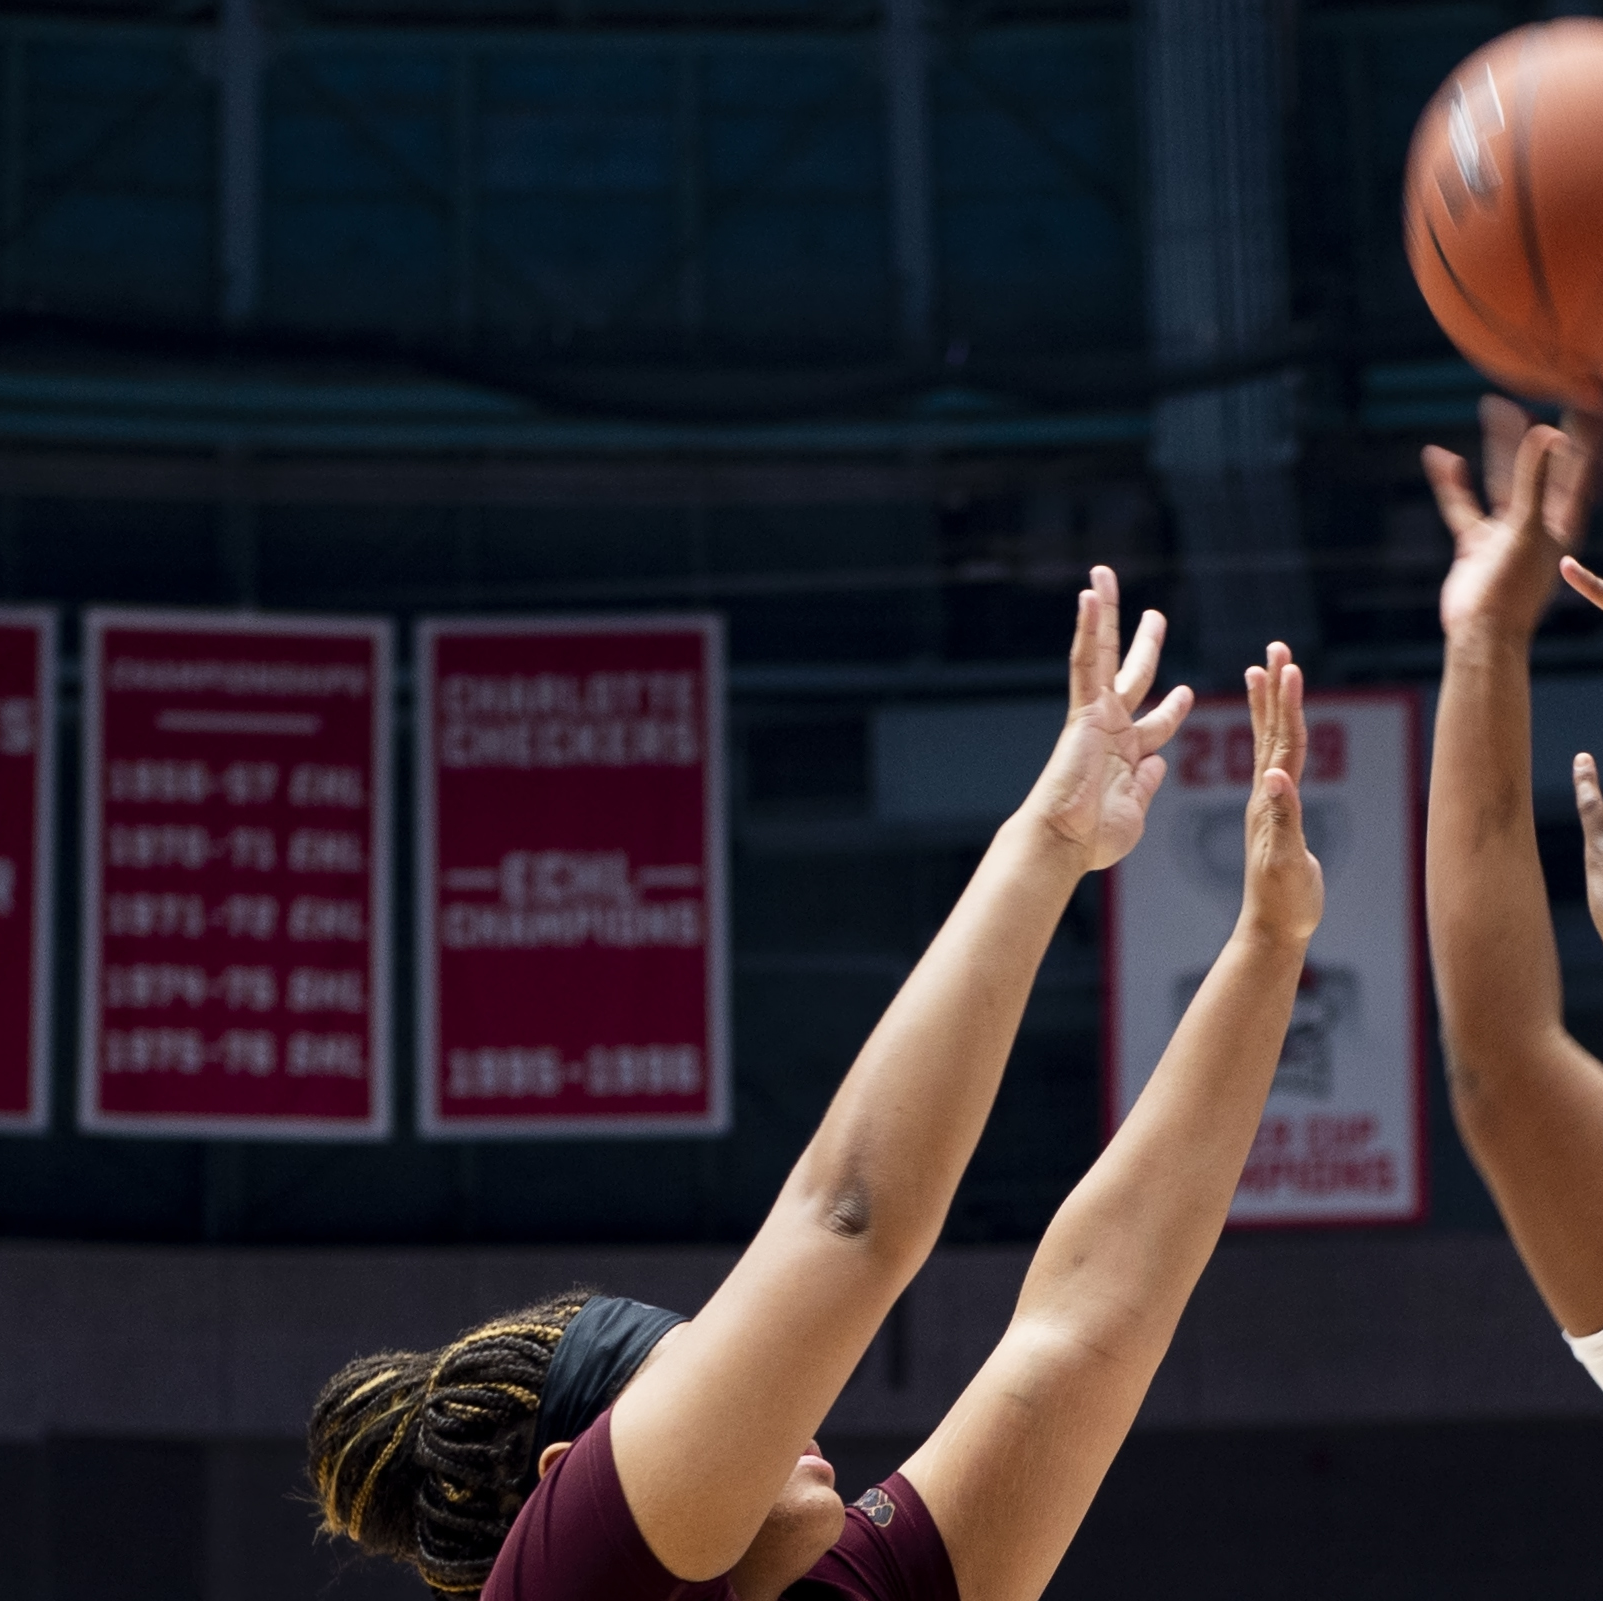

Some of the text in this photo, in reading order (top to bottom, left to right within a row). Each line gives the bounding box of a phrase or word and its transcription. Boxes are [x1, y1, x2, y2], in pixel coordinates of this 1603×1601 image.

[442, 668, 697, 718] CHARLOTTE
[442, 716, 697, 770] CHECKERS
[1175, 722, 1346, 788] 209
